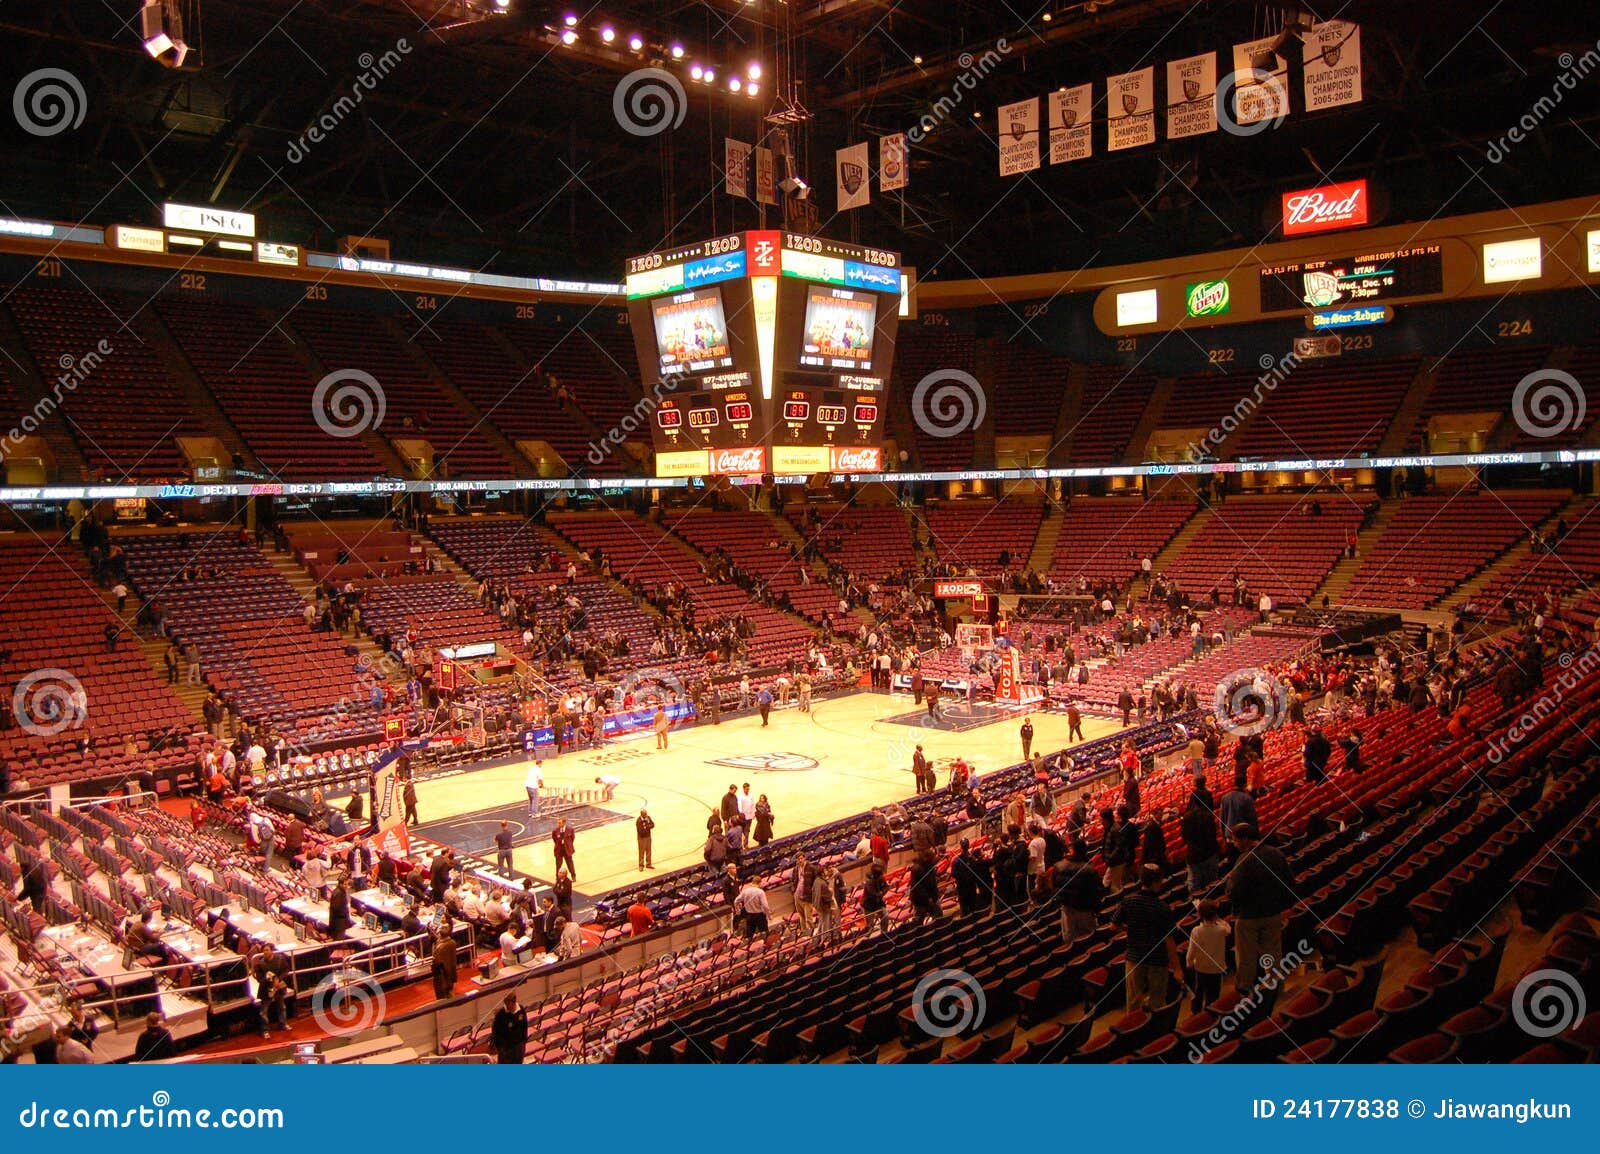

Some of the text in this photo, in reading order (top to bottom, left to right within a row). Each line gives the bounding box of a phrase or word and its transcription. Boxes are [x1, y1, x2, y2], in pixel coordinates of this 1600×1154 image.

[1318, 31, 1342, 43] NETS
[1180, 67, 1202, 78] NETS
[1306, 65, 1359, 84] ATLANTIC DIVISION
[1120, 82, 1140, 93] NETS
[1312, 79, 1353, 96] CHAMPIONS
[1061, 96, 1079, 107] NETS
[1313, 91, 1353, 106] 2005-2006
[1010, 110, 1028, 120] NETS
[1174, 111, 1210, 126] CHAMPIONS
[1114, 123, 1148, 138] CHAMPIONS
[1174, 122, 1210, 136] 2002-2003
[1054, 139, 1085, 153] CHAMPIONS
[1114, 134, 1148, 147] 2002-2003
[1004, 151, 1034, 164] CHAMPIONS
[1287, 189, 1361, 225] Bud
[631, 254, 663, 273] IZOD
[666, 248, 701, 261] CENTER
[704, 236, 740, 256] IZOD
[787, 234, 823, 253] IZOD
[827, 245, 861, 257] CENTER
[864, 249, 896, 267] IZOD
[1355, 251, 1395, 263] WARRIORS
[1397, 249, 1409, 258] FLS
[1411, 247, 1425, 255] PTS
[38, 260, 61, 277] 211
[1287, 264, 1299, 272] PTS
[1304, 261, 1326, 270] NETS
[1354, 266, 1375, 275] UTAH
[180, 274, 206, 290] 212
[1362, 280, 1380, 288] Dec.
[1383, 277, 1394, 286] 16
[305, 286, 328, 300] 213
[1351, 288, 1378, 298] 7:30pm
[416, 297, 436, 310] 214
[516, 306, 535, 319] 215
[1024, 304, 1048, 318] 220
[923, 313, 943, 326] 219
[1498, 320, 1534, 337] 224
[1117, 339, 1137, 351] 221
[1344, 335, 1373, 351] 223
[1208, 349, 1234, 363] 222
[794, 428, 799, 438] 5
[862, 430, 868, 439] 2
[1467, 455, 1523, 464] NJNETS.COM
[1177, 464, 1202, 473] DEC.16
[1241, 463, 1268, 471] DEC.19
[1317, 460, 1345, 468] DEC.23
[959, 471, 1005, 480] NJNETS.COM
[203, 485, 238, 495] DEC.16
[290, 484, 322, 494] DEC.19
[376, 482, 406, 492] DEC.23
[515, 480, 561, 489] NJNETS.COM
[937, 584, 963, 593] IZOD
[1002, 655, 1011, 699] IZOD
[380, 776, 395, 818] DOUBLEMINT
